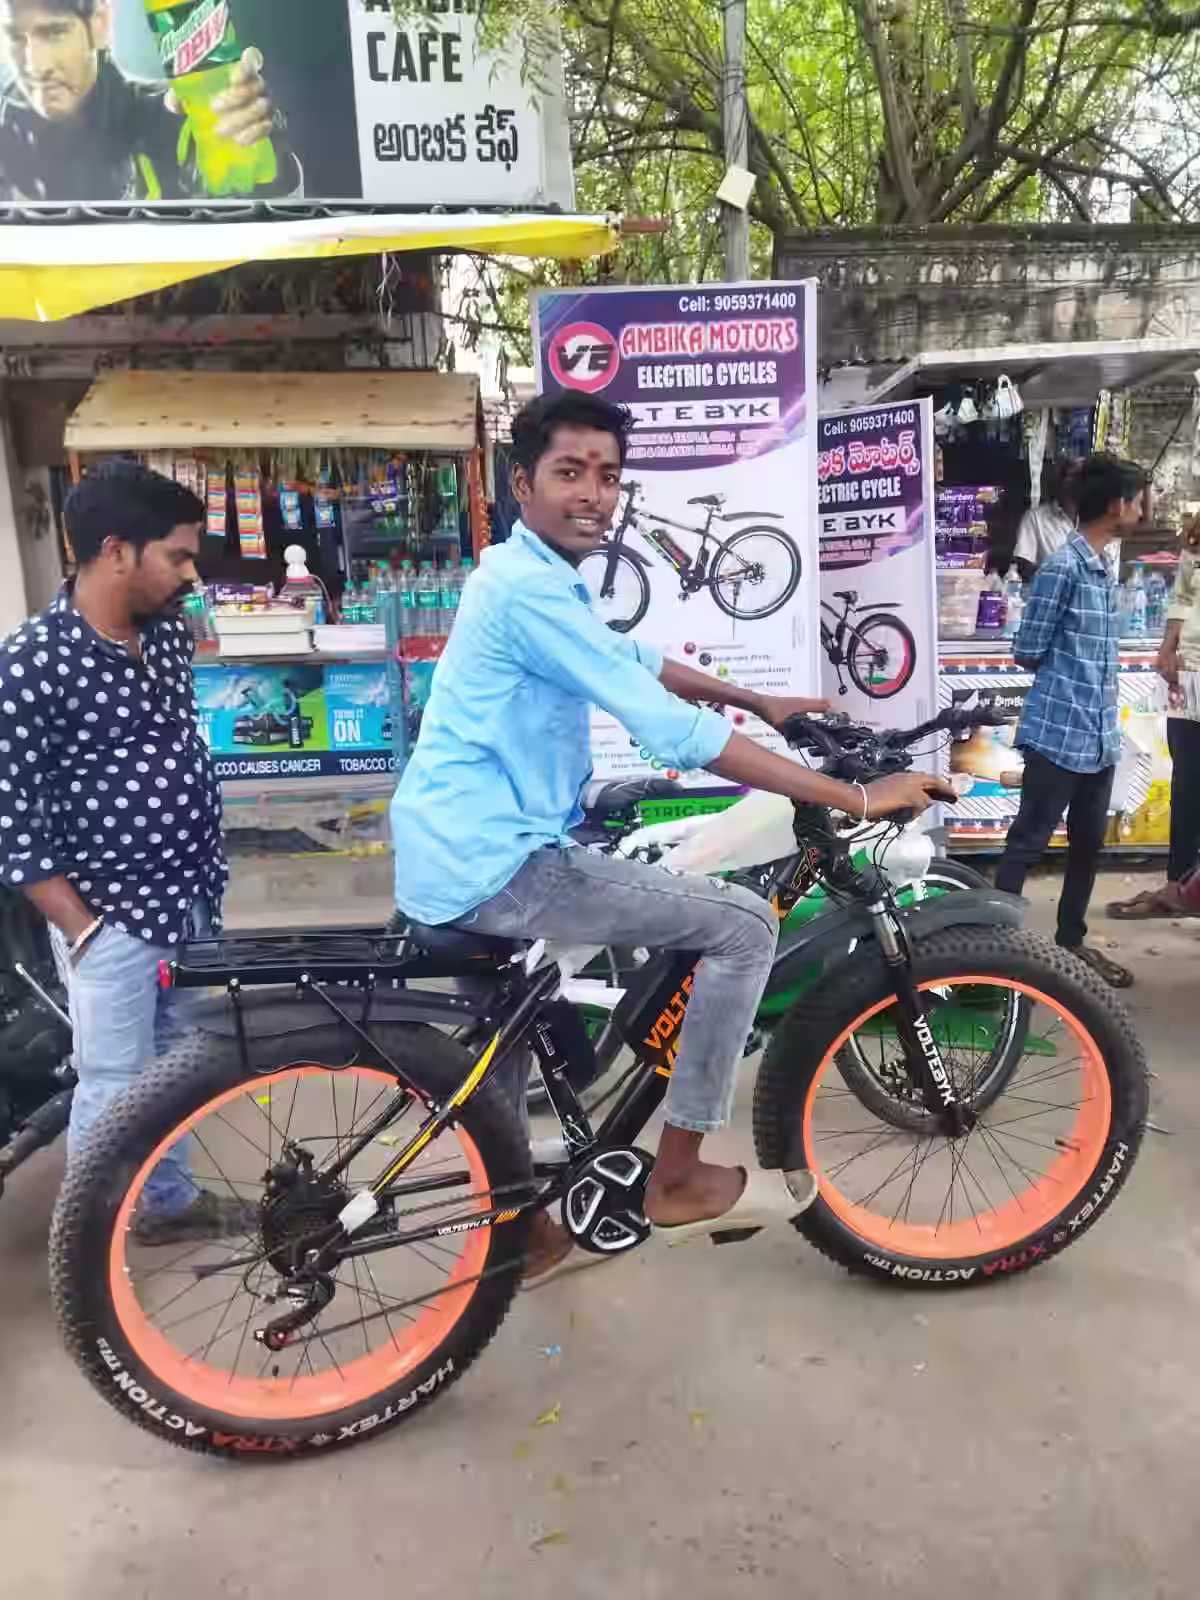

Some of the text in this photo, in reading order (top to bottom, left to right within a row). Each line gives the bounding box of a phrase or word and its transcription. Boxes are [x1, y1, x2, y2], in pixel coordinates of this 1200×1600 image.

[366, 31, 463, 82] CAFE
[374, 113, 467, 162] అంబిక
[678, 293, 796, 312] Cell: 9059371400
[622, 318, 797, 356] AMBIKA MOTORS
[637, 360, 777, 389] ELECTRIC CYCLES
[823, 409, 915, 436] Cell: 9059371400
[861, 476, 902, 500] CYCLE
[334, 720, 361, 742] ON
[240, 759, 279, 774] CAUSES
[280, 758, 321, 772] CANCER
[339, 757, 387, 772] TOBACCO
[913, 1013, 956, 1107] VOLTEBYK
[1068, 1141, 1129, 1231] HARTEX
[890, 1263, 977, 1282] ACTION
[112, 1371, 208, 1438] ACTION
[336, 1357, 455, 1441] HARTEX
